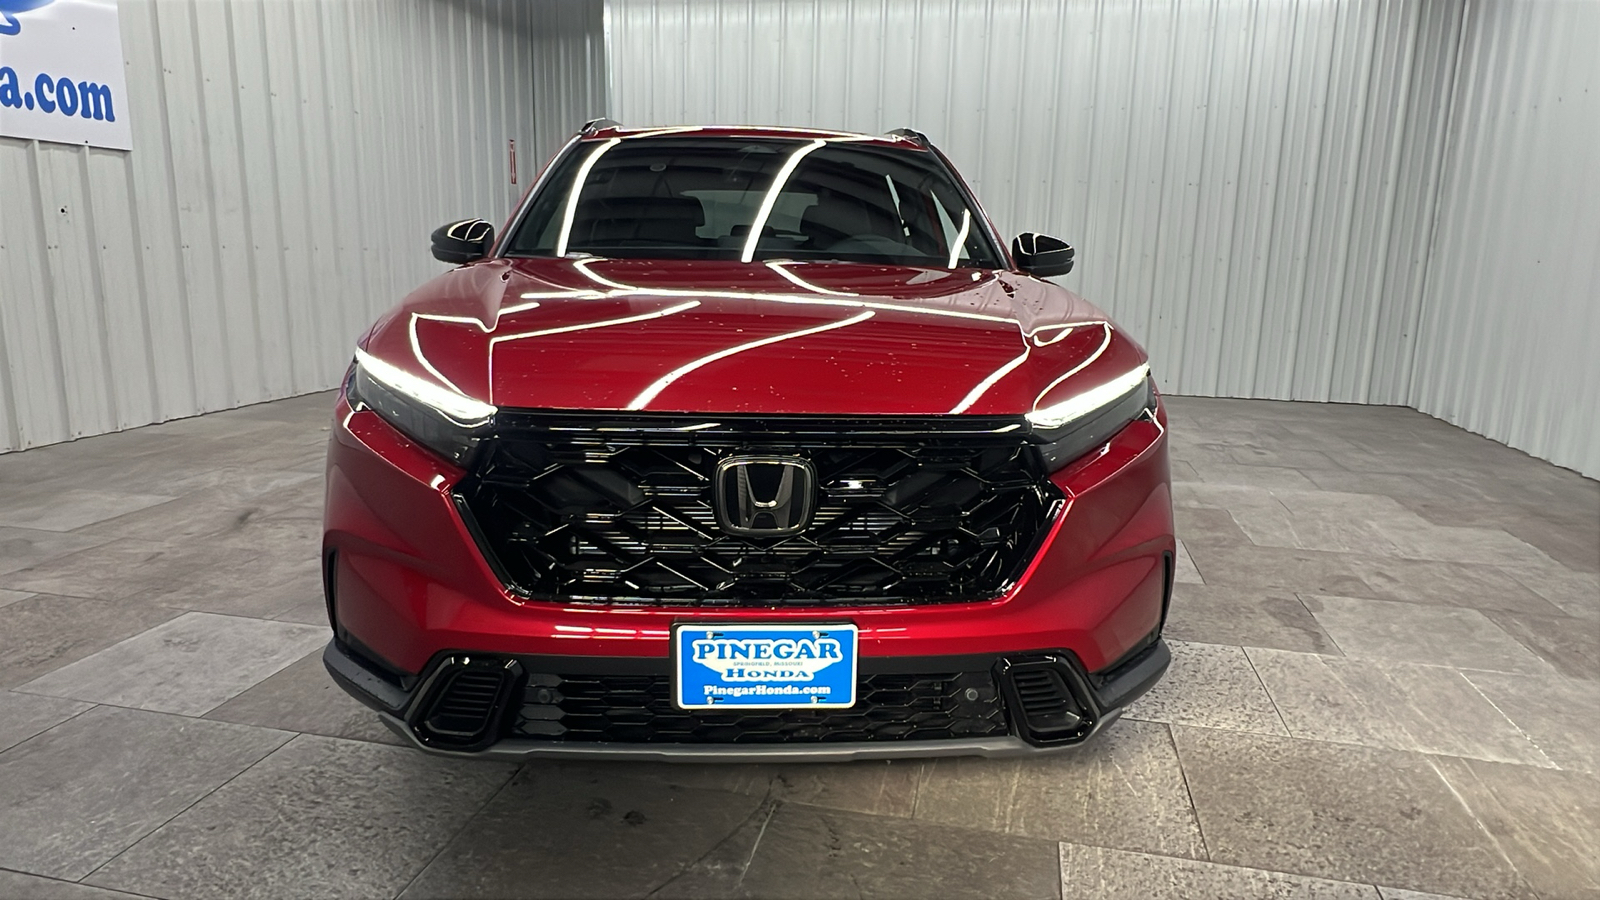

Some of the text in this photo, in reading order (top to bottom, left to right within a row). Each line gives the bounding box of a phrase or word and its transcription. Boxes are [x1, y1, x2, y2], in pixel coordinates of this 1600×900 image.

[697, 642, 839, 660] PINEGAR
[726, 668, 809, 678] HONDA
[703, 685, 831, 697] PinegarHonda.com
